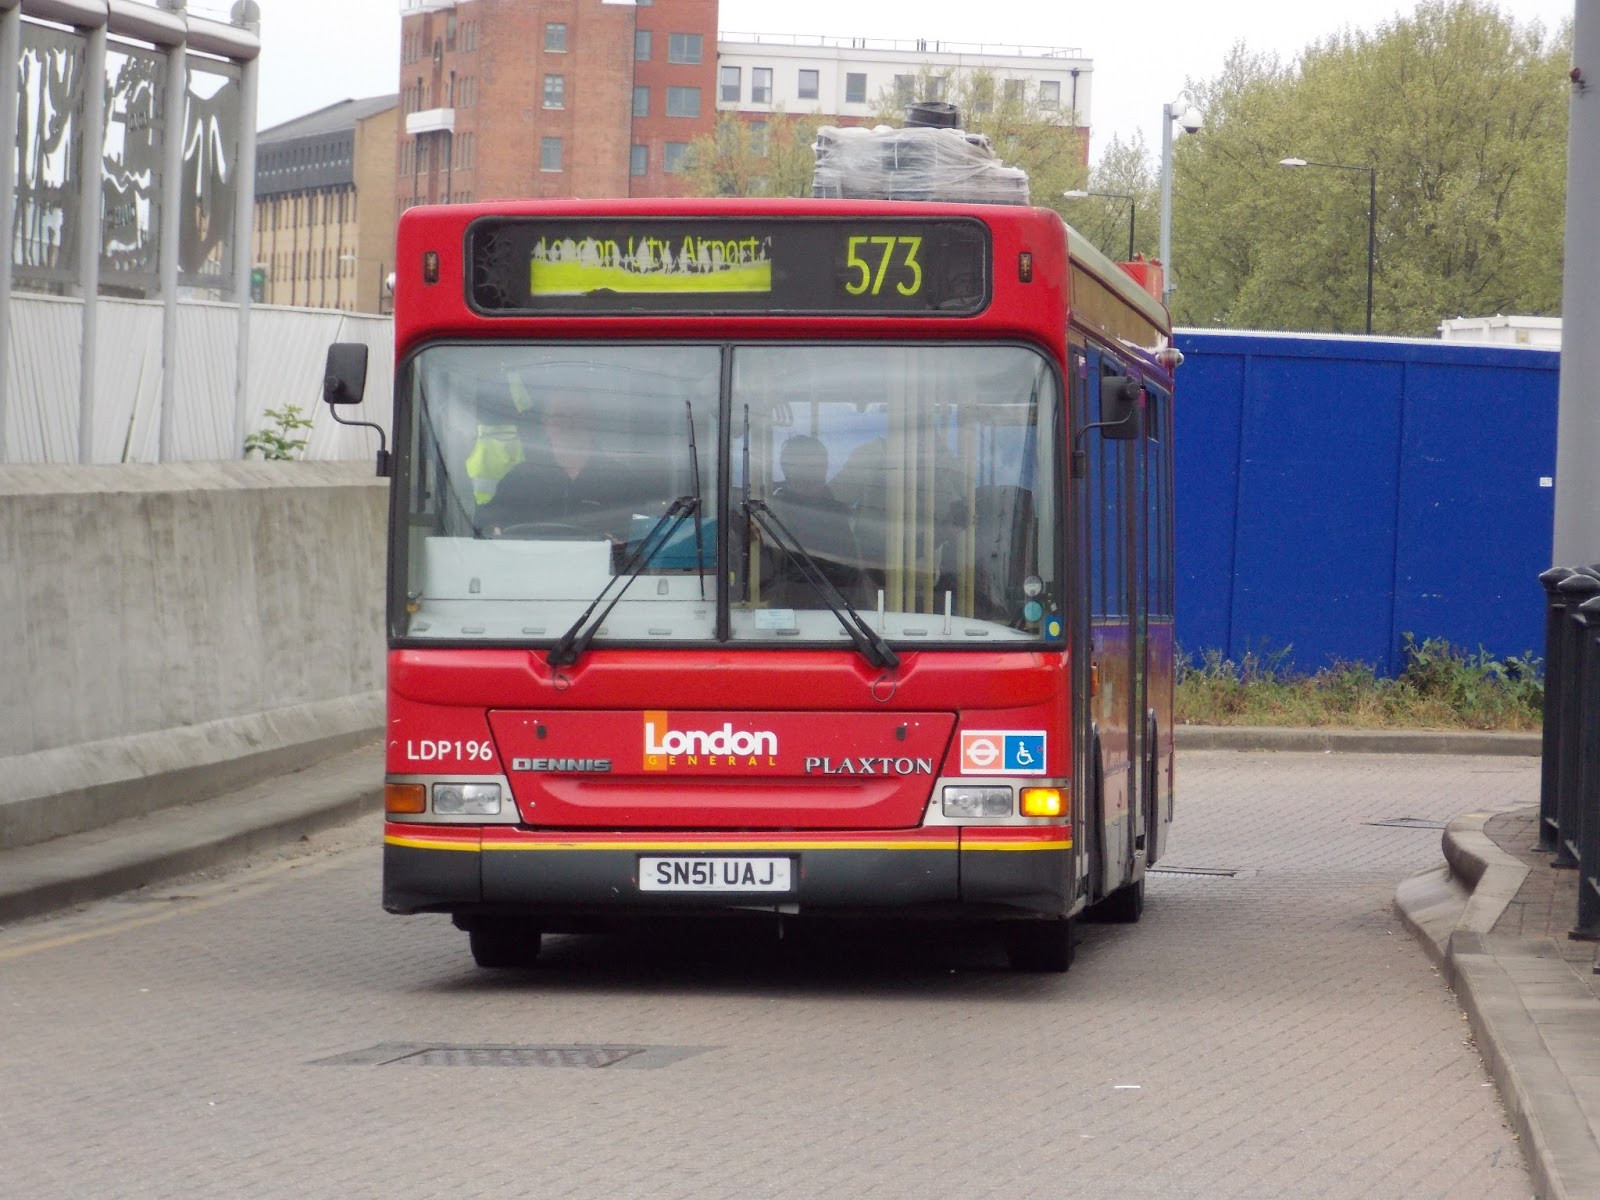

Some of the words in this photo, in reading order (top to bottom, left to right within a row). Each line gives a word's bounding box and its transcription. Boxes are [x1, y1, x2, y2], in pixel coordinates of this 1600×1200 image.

[540, 235, 620, 267] Loon
[628, 235, 670, 269] Cty
[680, 234, 760, 270] Airport
[845, 236, 923, 296] 573
[645, 722, 778, 756] London
[406, 740, 493, 761] LDP196
[648, 755, 776, 766] GENERAL
[511, 757, 612, 773] DENNIS
[804, 757, 933, 775] PLAXTON
[656, 861, 715, 885] SN51
[723, 861, 774, 885] UAJ
